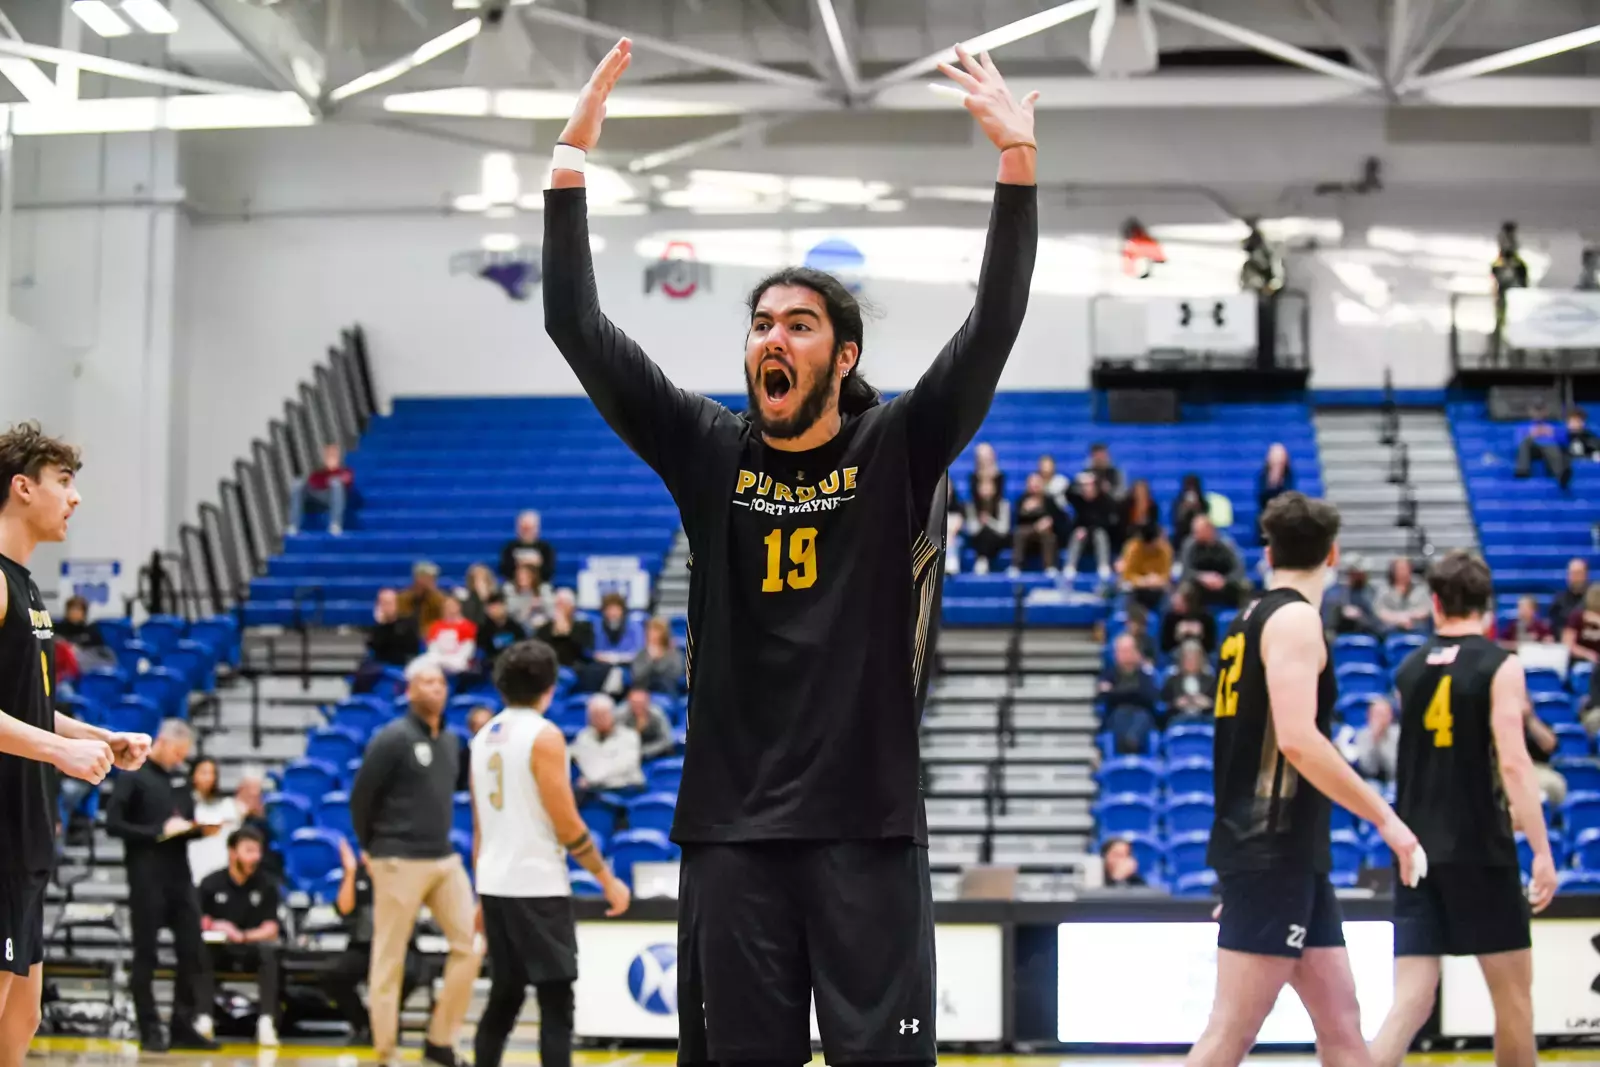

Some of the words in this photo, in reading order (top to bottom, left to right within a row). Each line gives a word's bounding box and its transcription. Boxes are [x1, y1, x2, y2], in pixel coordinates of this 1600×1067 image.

[735, 466, 859, 503] PURDUE
[761, 527, 818, 592] 19
[1424, 675, 1453, 747] 4
[487, 751, 504, 811] 3
[5, 937, 14, 961] 8
